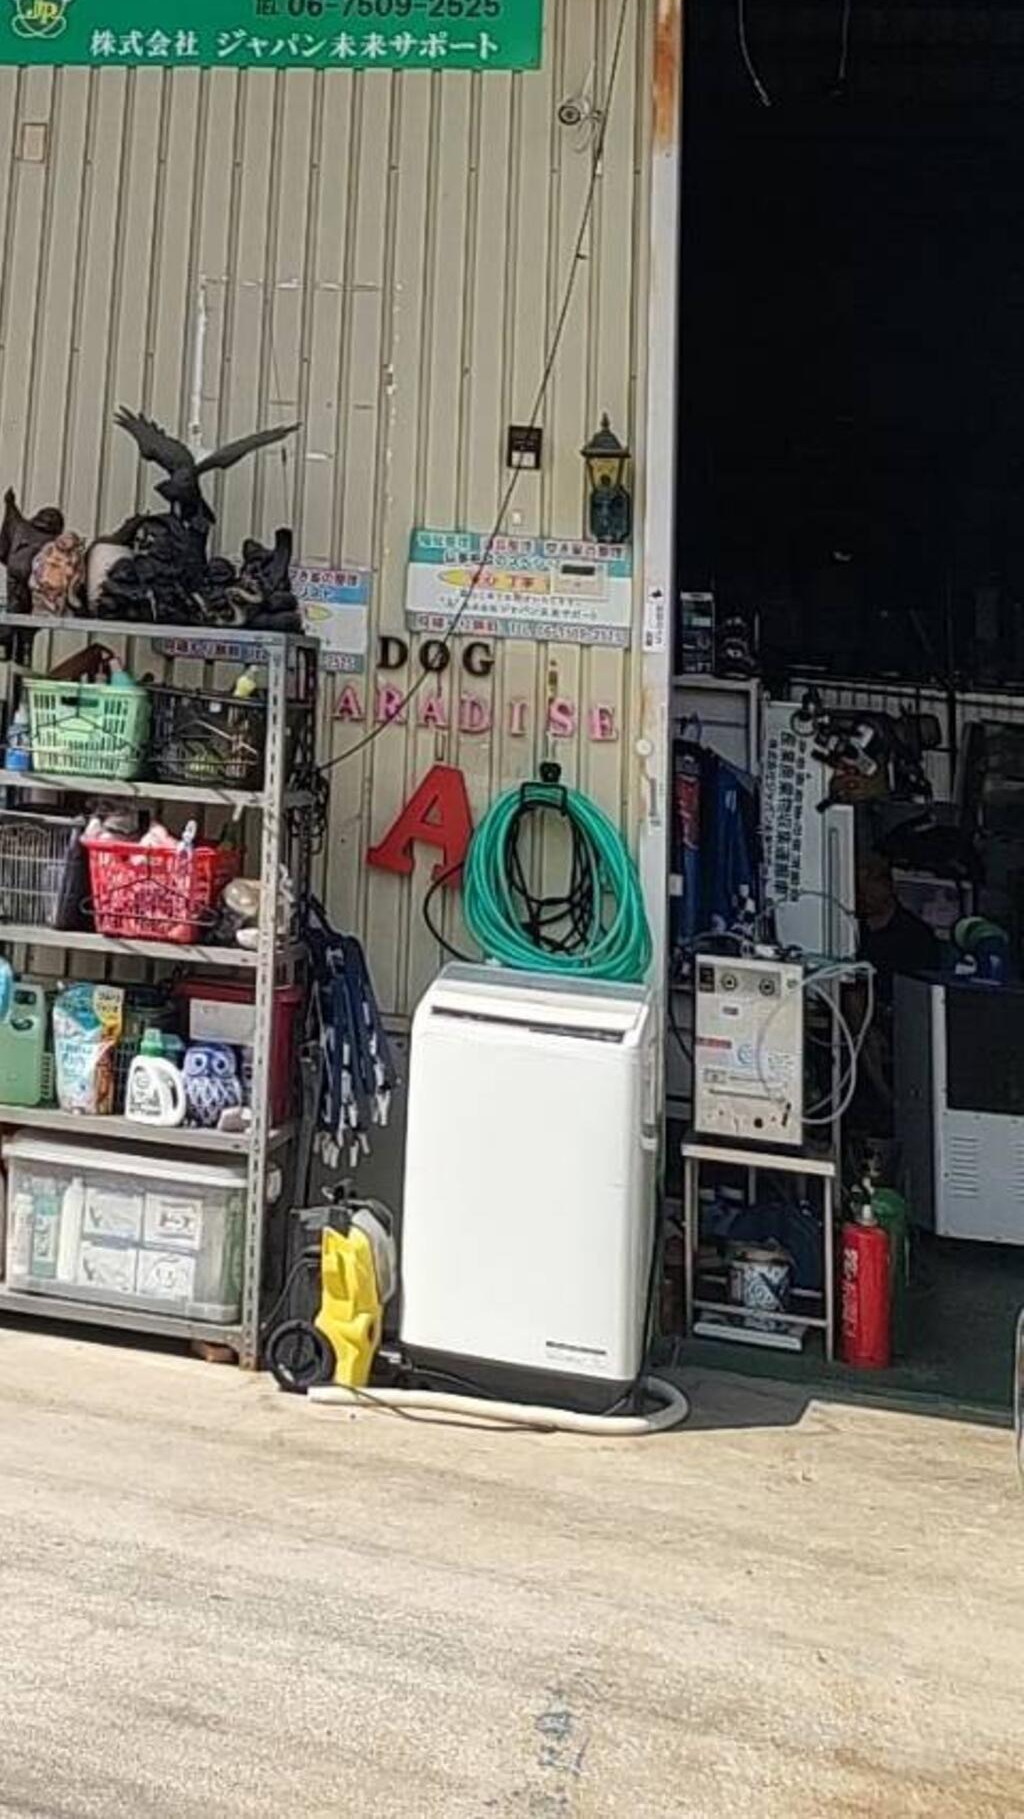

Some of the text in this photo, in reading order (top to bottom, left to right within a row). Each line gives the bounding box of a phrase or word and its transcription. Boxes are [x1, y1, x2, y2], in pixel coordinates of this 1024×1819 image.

[90, 29, 499, 61] 株式会社 ジャパン未来サポート
[377, 636, 495, 677] DOG
[332, 682, 620, 742] ARADISE
